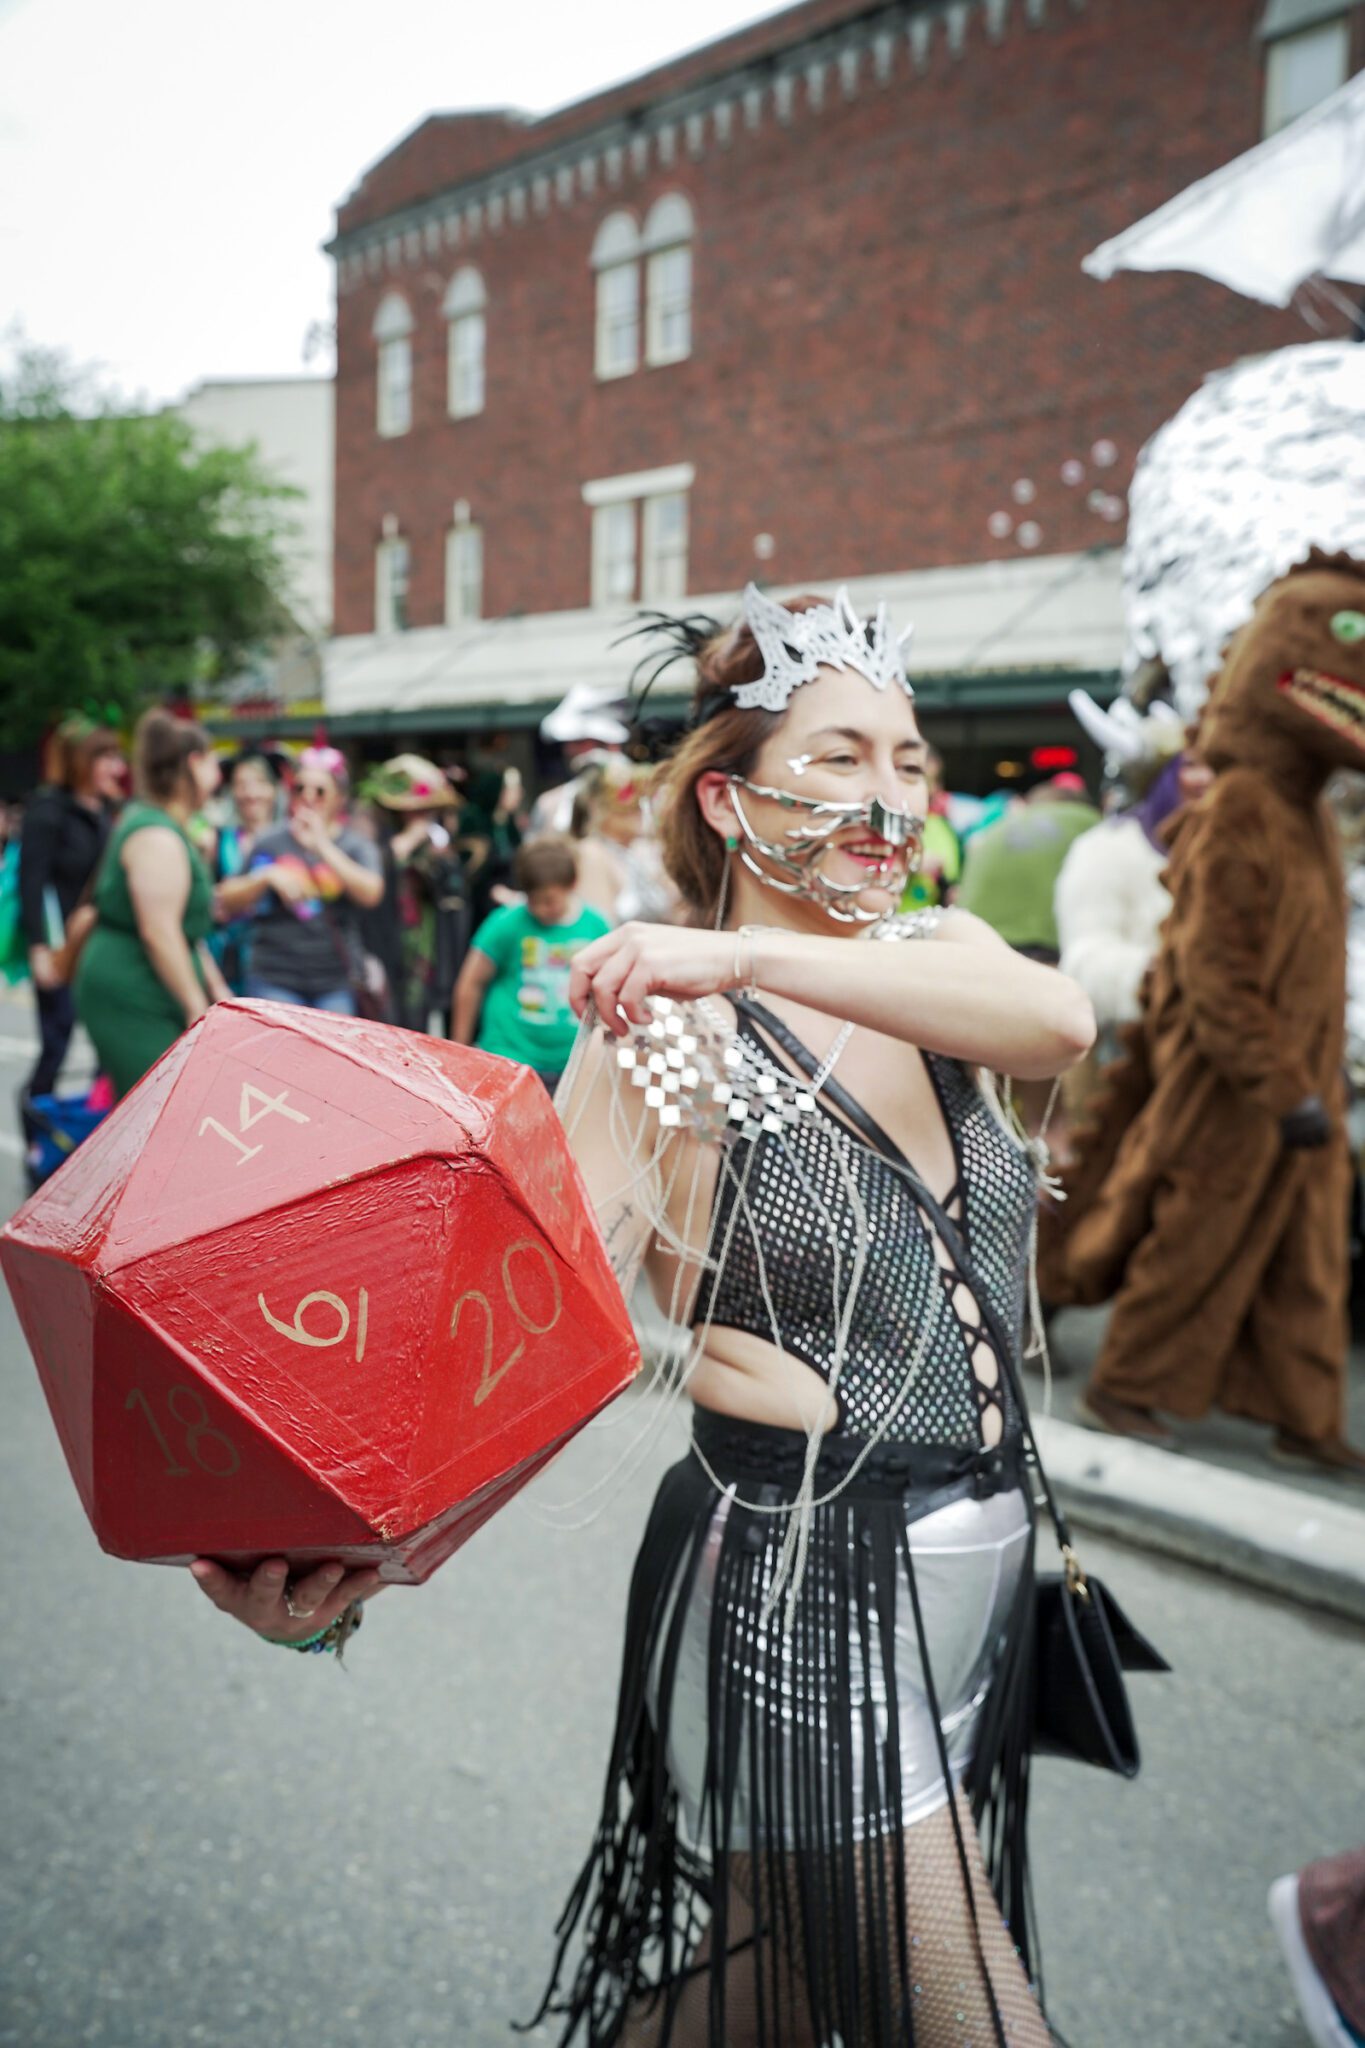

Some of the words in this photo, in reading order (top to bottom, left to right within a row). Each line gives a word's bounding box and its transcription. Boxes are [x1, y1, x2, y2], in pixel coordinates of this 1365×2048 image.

[199, 1081, 311, 1167] 14
[450, 1237, 562, 1408] 20
[124, 1384, 241, 1478] 18
